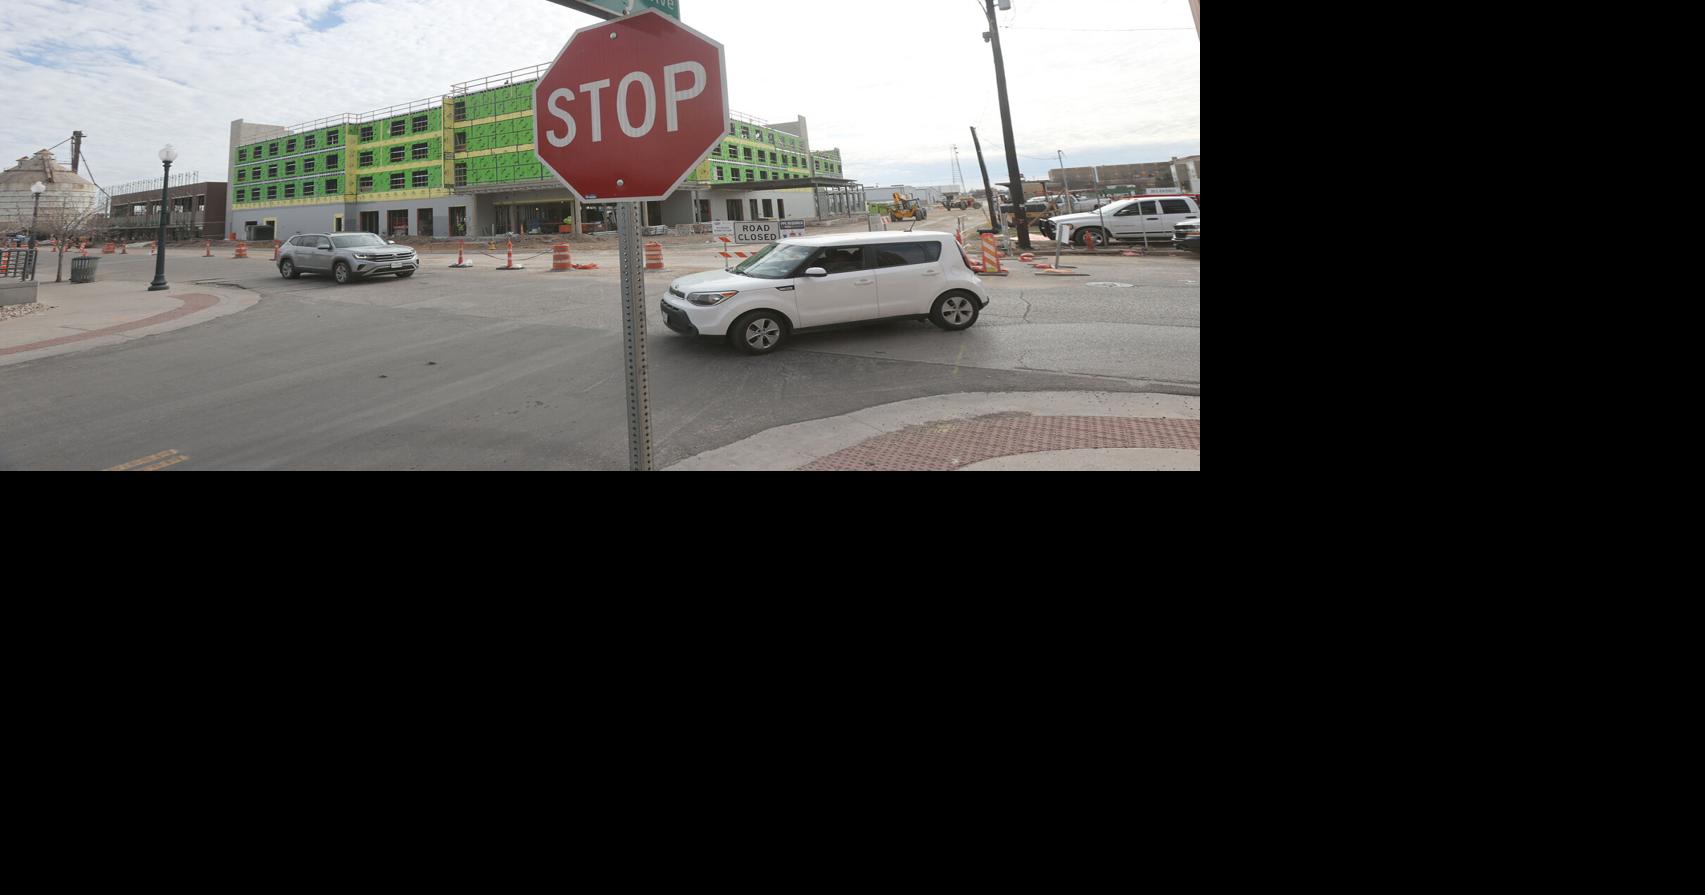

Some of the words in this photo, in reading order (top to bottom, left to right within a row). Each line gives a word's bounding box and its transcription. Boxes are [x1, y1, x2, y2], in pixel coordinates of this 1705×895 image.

[546, 60, 707, 148] STOP
[742, 224, 771, 232] ROAD
[737, 233, 777, 241] CLOSED
